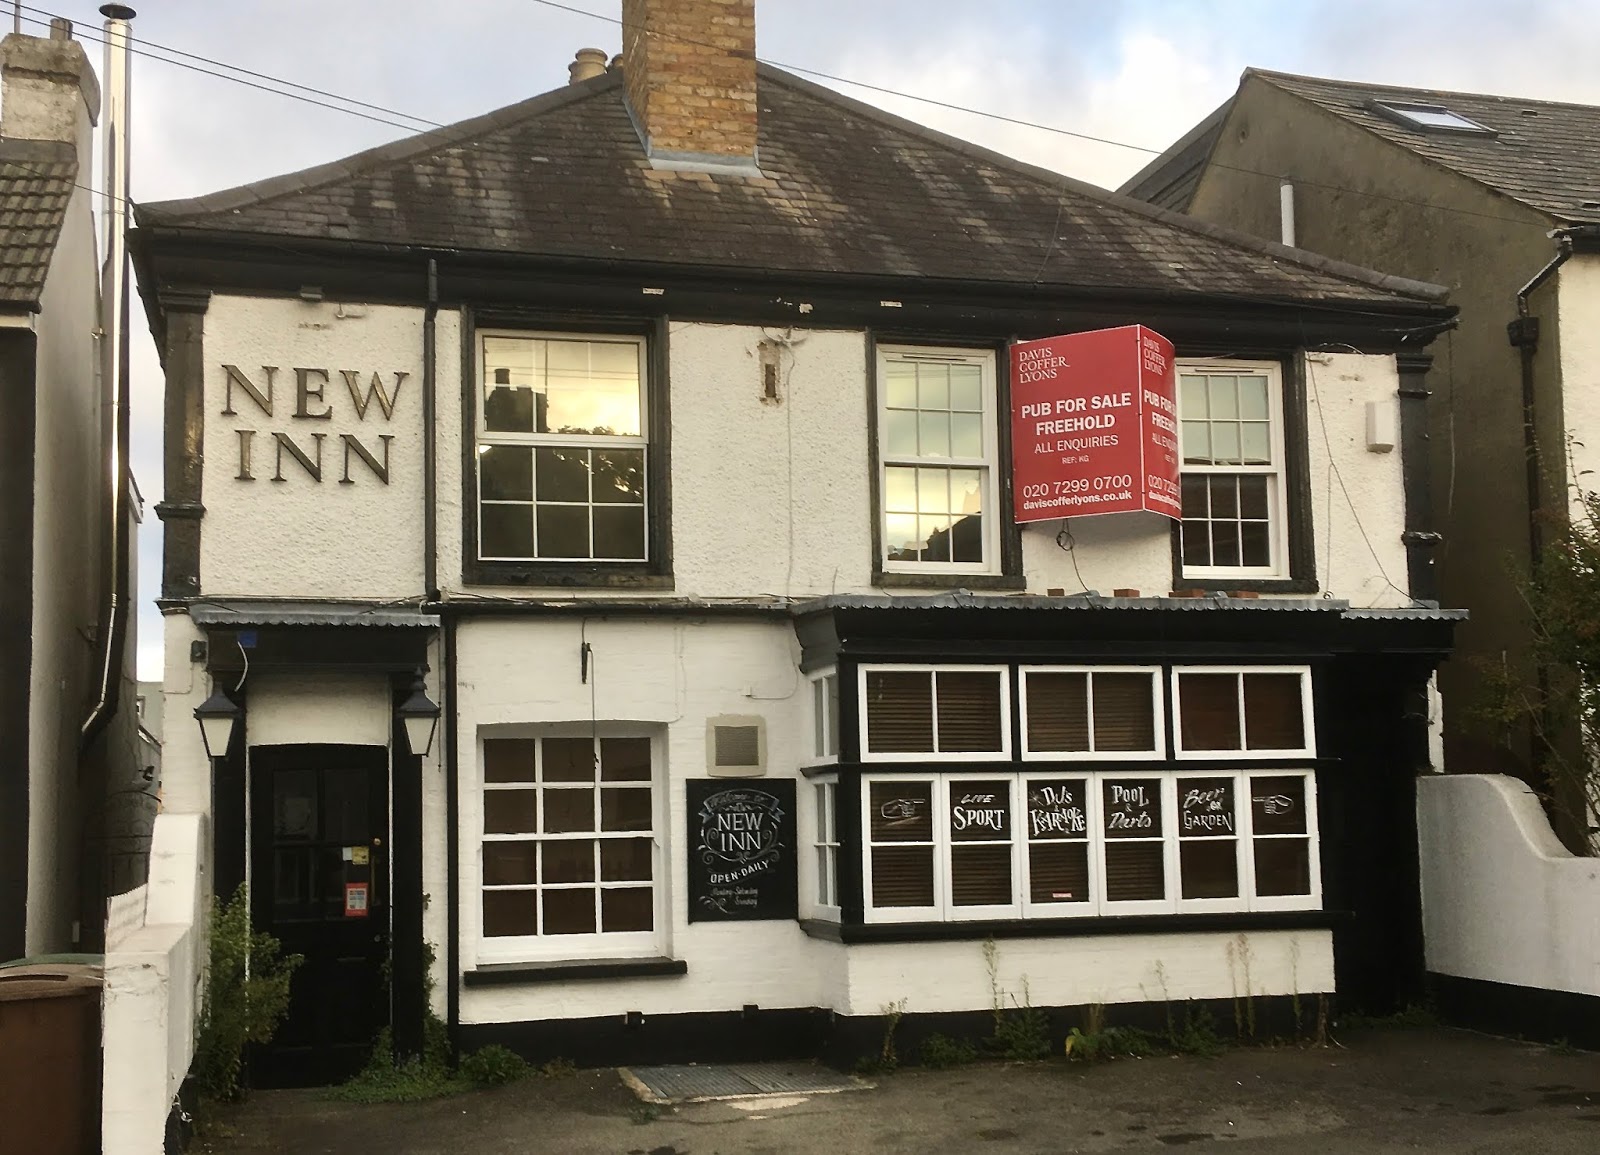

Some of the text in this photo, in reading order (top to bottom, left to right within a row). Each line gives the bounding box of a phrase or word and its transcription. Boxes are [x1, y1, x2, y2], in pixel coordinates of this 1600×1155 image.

[1019, 347, 1053, 361] DAVIS
[1019, 356, 1071, 372] COFFER
[1019, 368, 1058, 383] LYONS
[221, 364, 410, 421] NEW
[1143, 389, 1160, 407] PUB
[1021, 392, 1132, 418] PUB FOR SALE
[1036, 414, 1116, 435] FREEHOLD
[1034, 434, 1119, 454] ALL ENQUIRIES
[234, 429, 395, 485] INN
[1062, 454, 1089, 464] REF: KG
[1023, 474, 1132, 498] 020 7299 0700
[1023, 489, 1133, 510] daviscofferlyons.co.uk
[717, 812, 764, 832] NEW
[953, 806, 1005, 831] SPORT
[720, 831, 761, 852] INN
